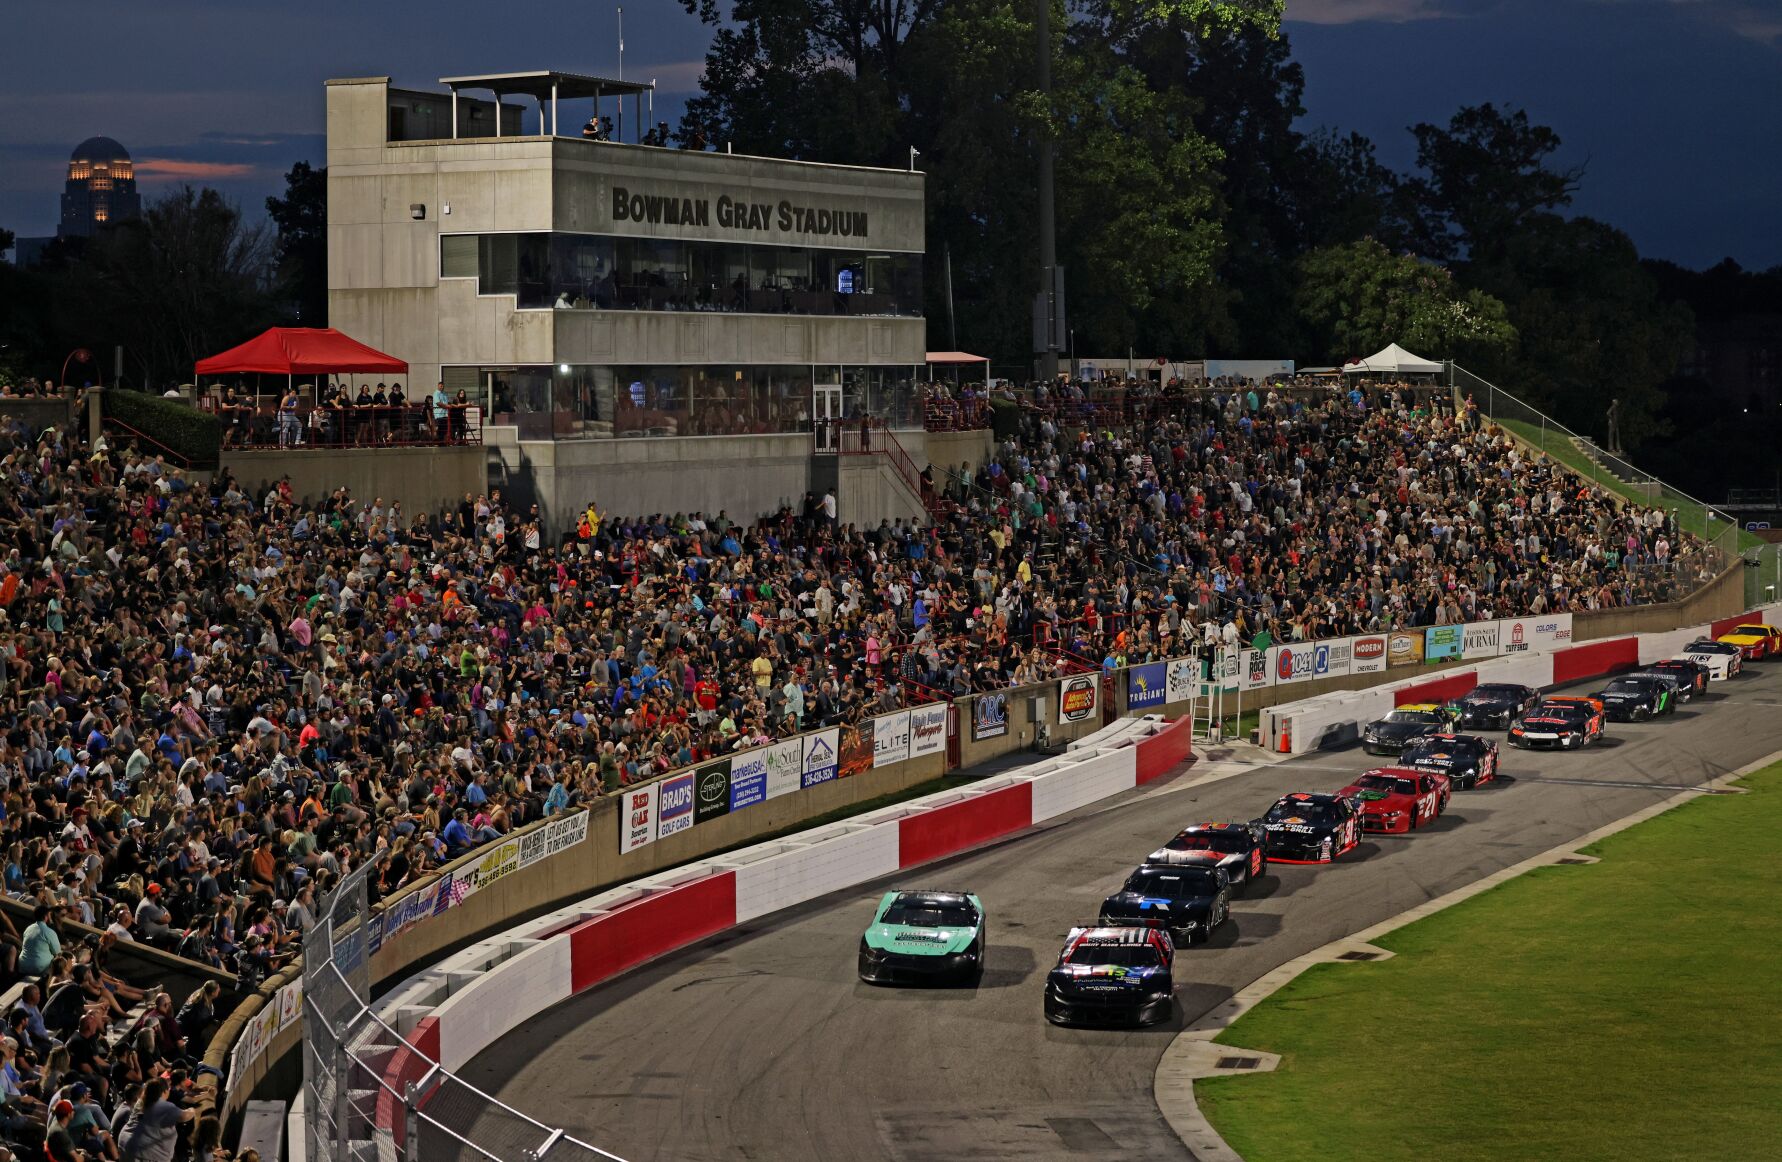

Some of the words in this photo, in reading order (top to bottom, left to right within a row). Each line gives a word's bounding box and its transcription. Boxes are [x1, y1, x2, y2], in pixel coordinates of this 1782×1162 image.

[613, 187, 709, 226] BOWMAN
[717, 195, 773, 231] GRAY
[778, 201, 868, 237] STADIUM
[1356, 643, 1382, 654] MODERN
[1462, 634, 1497, 652] JOURNAL
[1250, 651, 1266, 661] REAL
[1249, 660, 1266, 677] ROCK
[874, 733, 908, 752] ELITE
[632, 793, 649, 811] RED
[662, 785, 691, 811] BRAD'S
[661, 822, 676, 836] GOLF
[676, 816, 690, 830] CARS
